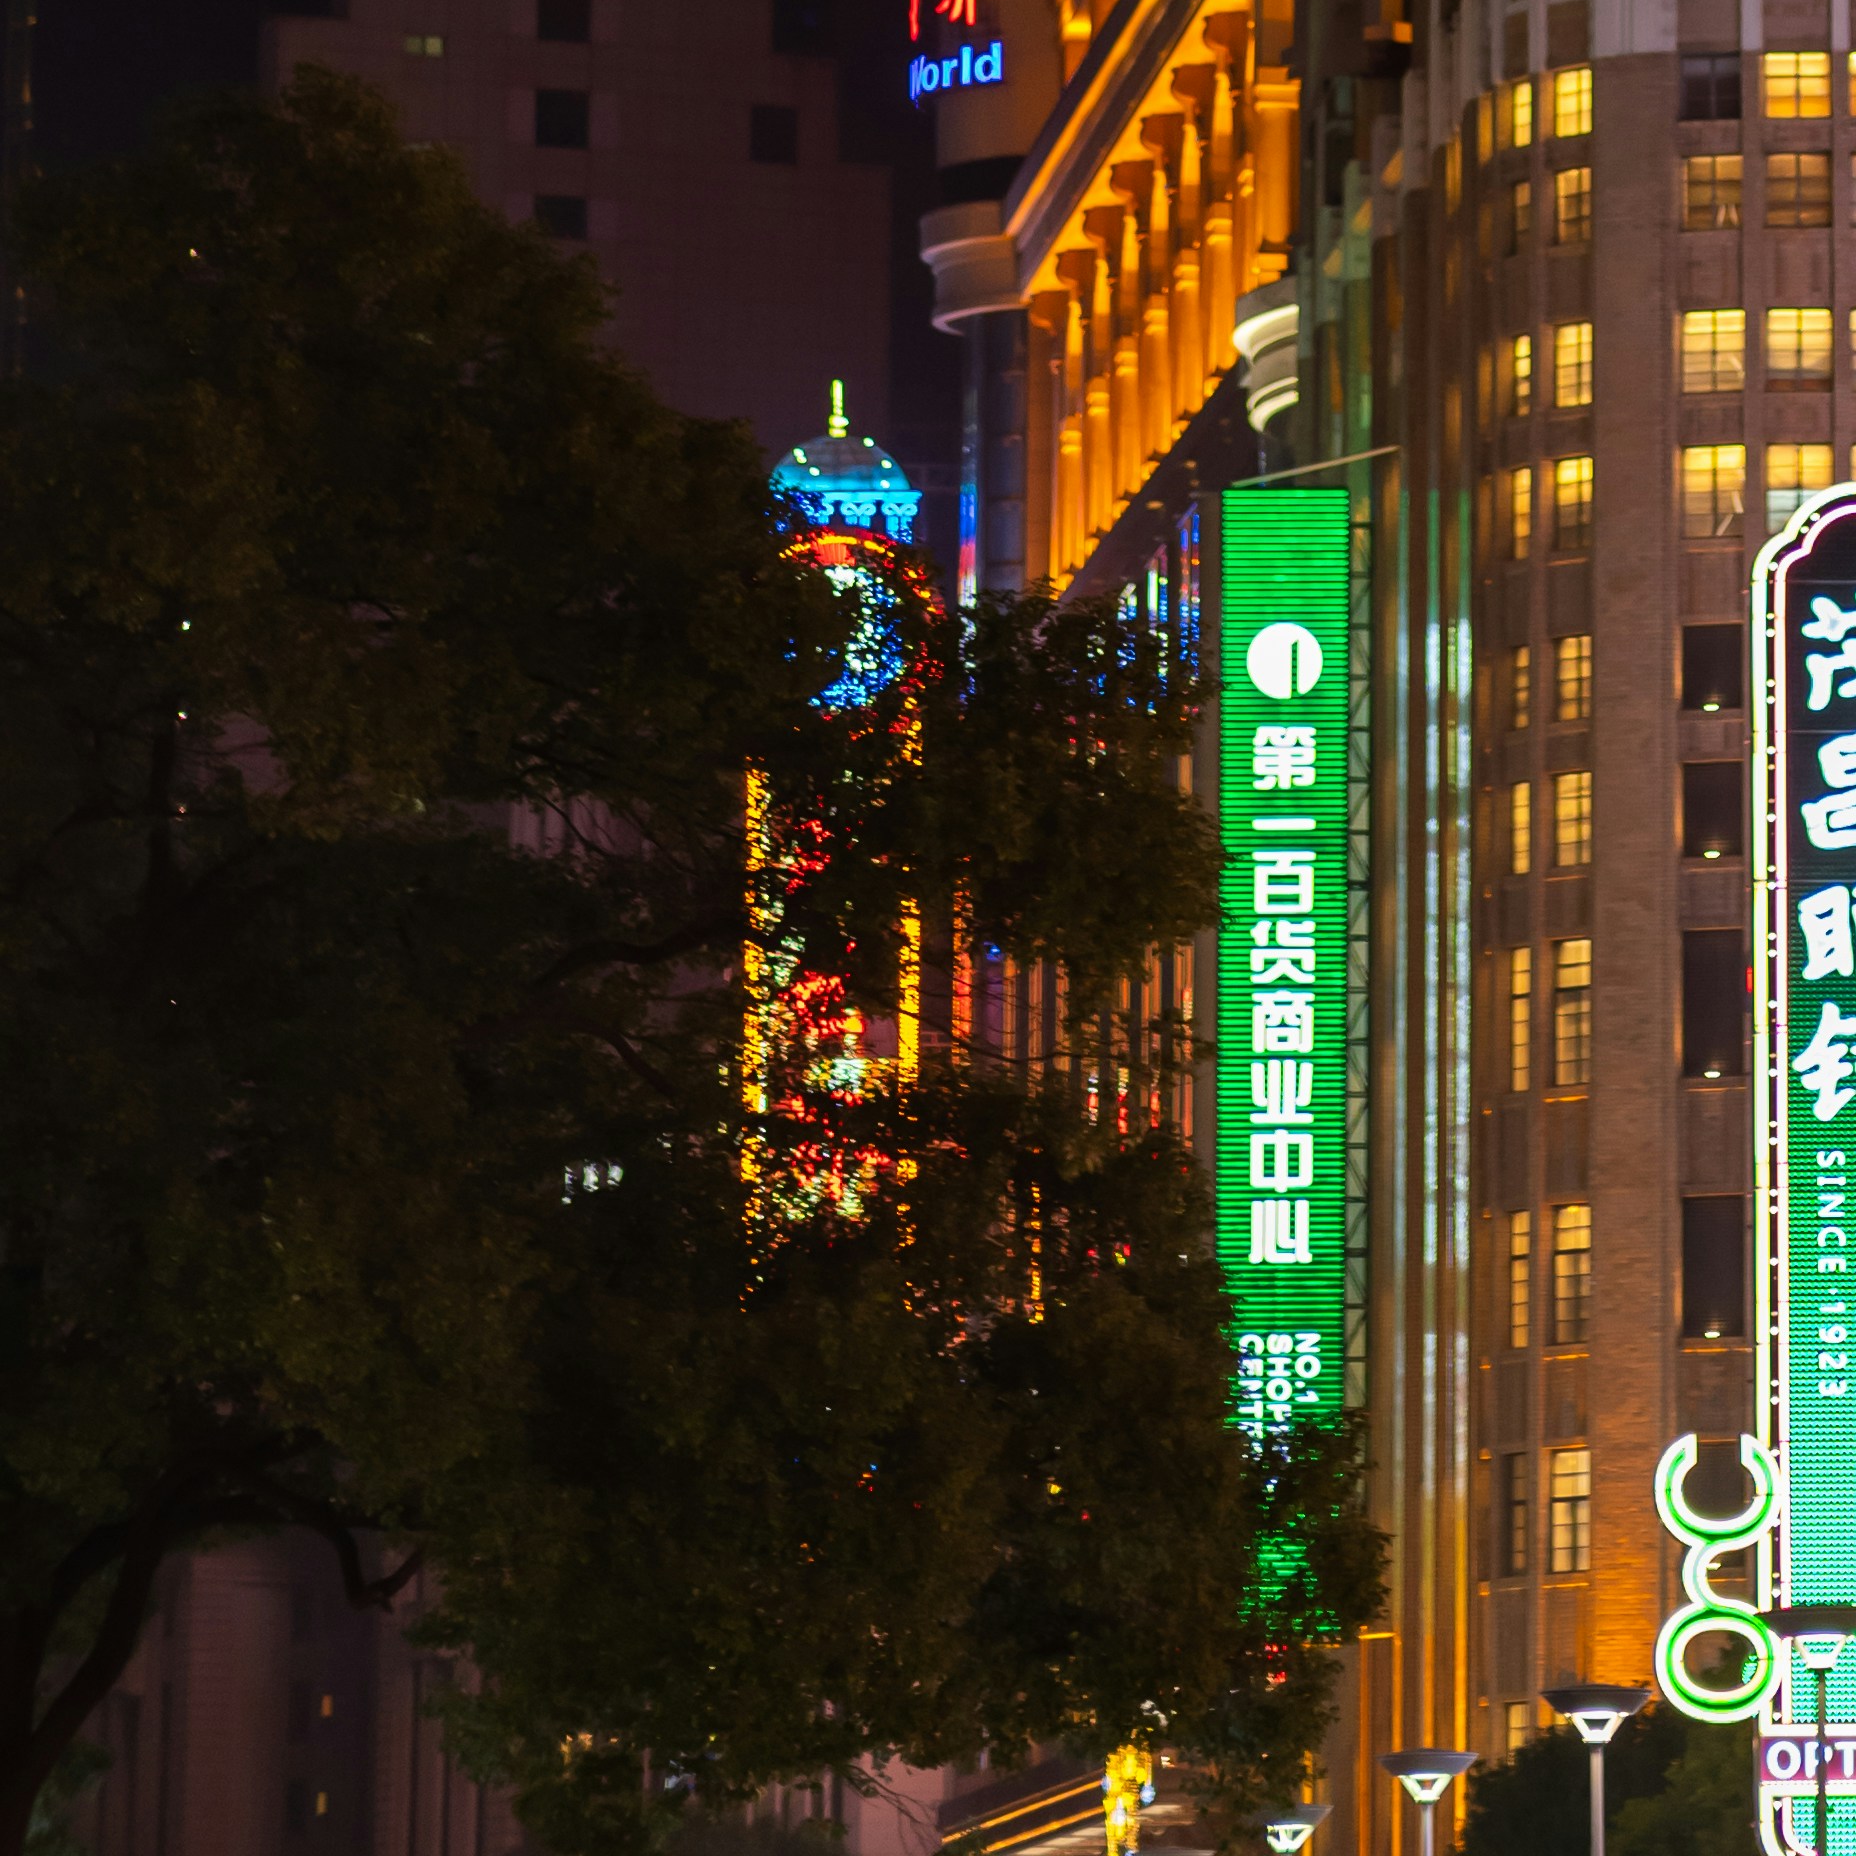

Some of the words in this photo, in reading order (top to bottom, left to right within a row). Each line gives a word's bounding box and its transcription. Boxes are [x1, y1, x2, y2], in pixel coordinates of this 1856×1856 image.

[1246, 724, 1318, 1267] 第一百货商业中心
[1816, 1149, 1847, 1276] SINCE
[1294, 1332, 1322, 1404] NO.1
